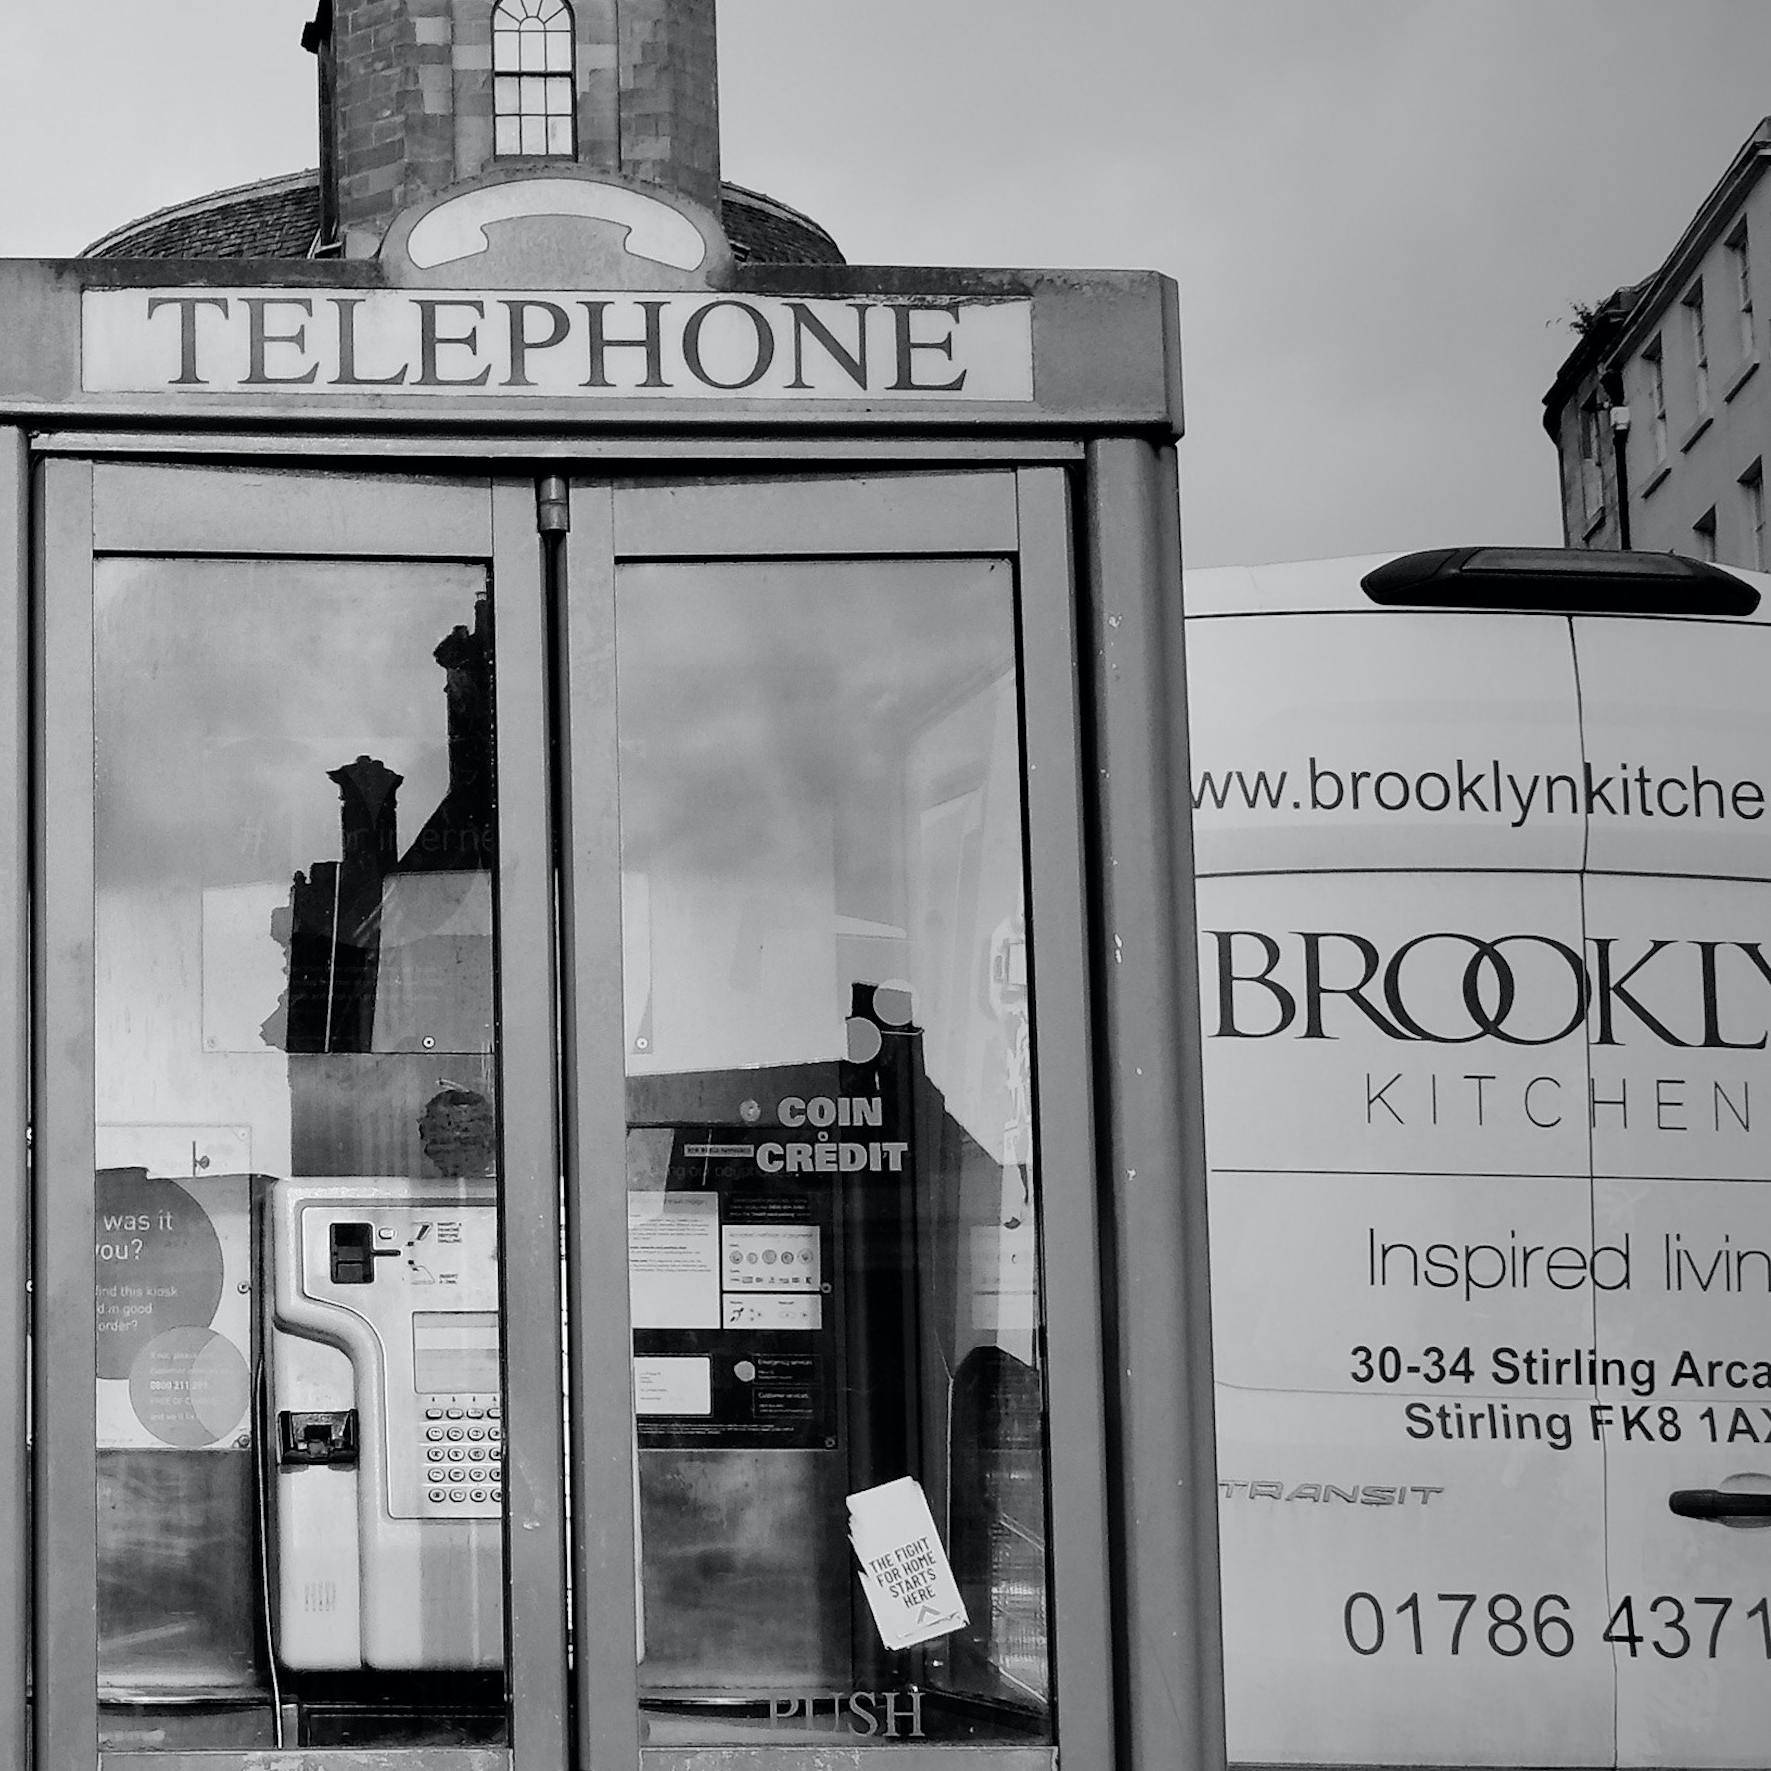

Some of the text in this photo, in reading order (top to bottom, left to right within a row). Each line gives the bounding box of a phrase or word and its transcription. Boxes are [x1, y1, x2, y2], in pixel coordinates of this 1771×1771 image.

[146, 297, 967, 391] TELEPHONE
[777, 1096, 882, 1127] COIN
[1365, 1072, 1750, 1133] KITCHEN
[756, 1142, 908, 1172] CREDIT
[104, 1209, 173, 1231] was it
[1368, 1228, 1771, 1301] Inspired livin
[124, 1303, 153, 1316] good
[1350, 1346, 1475, 1385] 30-34
[1491, 1347, 1656, 1396] Stirling
[1404, 1402, 1574, 1450] Stirling
[1589, 1405, 1682, 1442] FK8
[1218, 1480, 1445, 1507] TRANSIT
[869, 1536, 930, 1575] THE FIGHT
[875, 1551, 937, 1588] FOR HOME
[889, 1568, 937, 1598] STARTS
[903, 1586, 937, 1609] HERE
[1342, 1591, 1771, 1659] 01786 4371
[769, 1691, 927, 1738] PUSH
